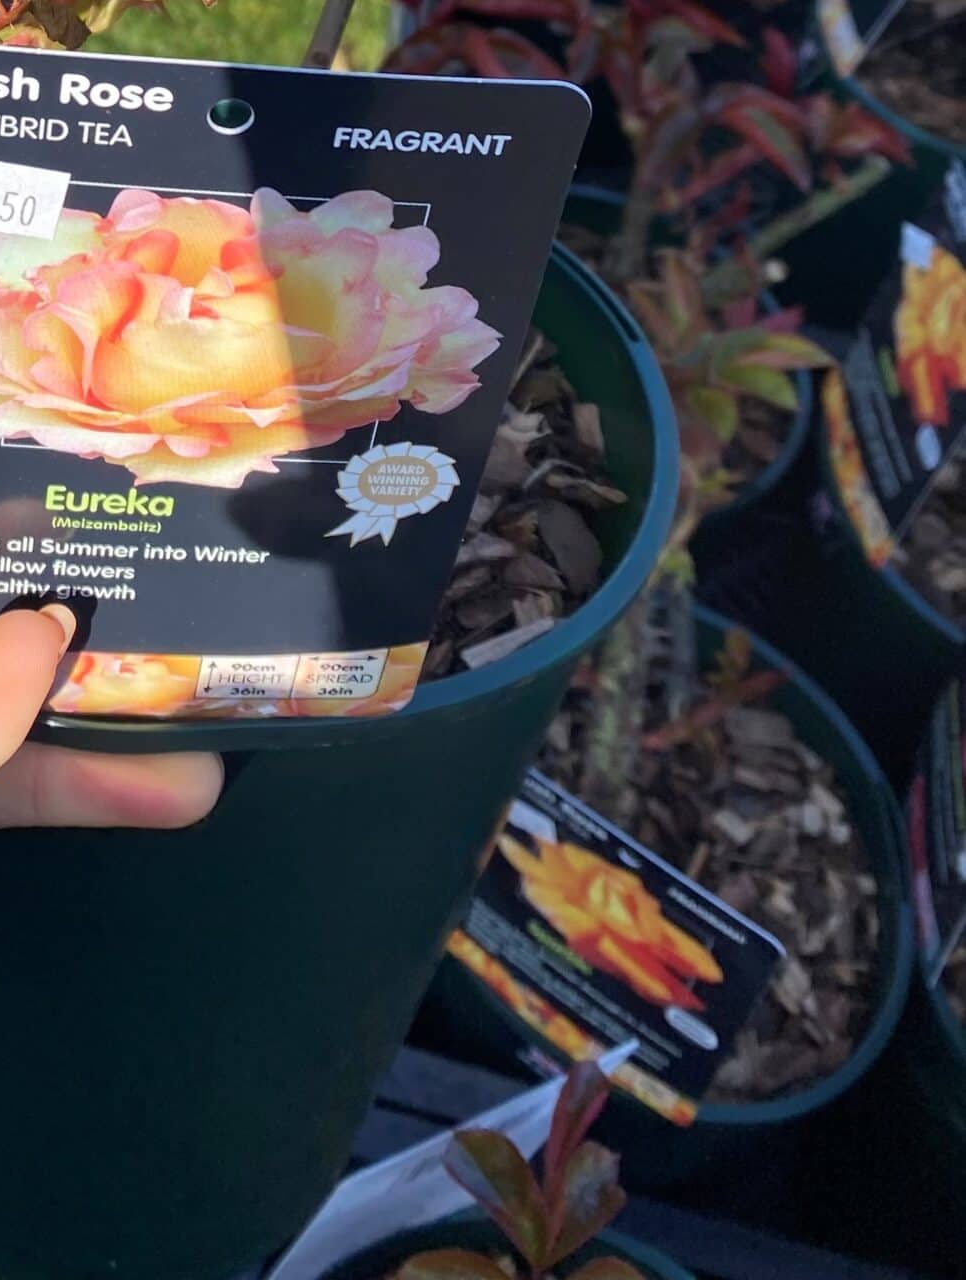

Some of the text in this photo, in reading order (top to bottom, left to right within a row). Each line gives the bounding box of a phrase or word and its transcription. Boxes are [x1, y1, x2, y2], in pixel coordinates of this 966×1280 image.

[59, 72, 174, 112] Rose
[78, 121, 133, 147] TEA
[333, 127, 512, 156] FRAGRANT
[377, 464, 425, 475] AWARD
[367, 474, 430, 486] WINNING
[370, 484, 422, 496] VARIETY
[45, 484, 175, 517] Eureka
[6, 536, 34, 553] all
[40, 538, 138, 559] Summer
[144, 543, 187, 561] into
[194, 545, 271, 564] Winter
[52, 560, 136, 580] flowers
[56, 583, 136, 601] growth
[231, 663, 276, 672] 90cm
[320, 663, 365, 672] 90cm
[218, 673, 284, 685] HEIGHT
[305, 673, 374, 684] SPREAD
